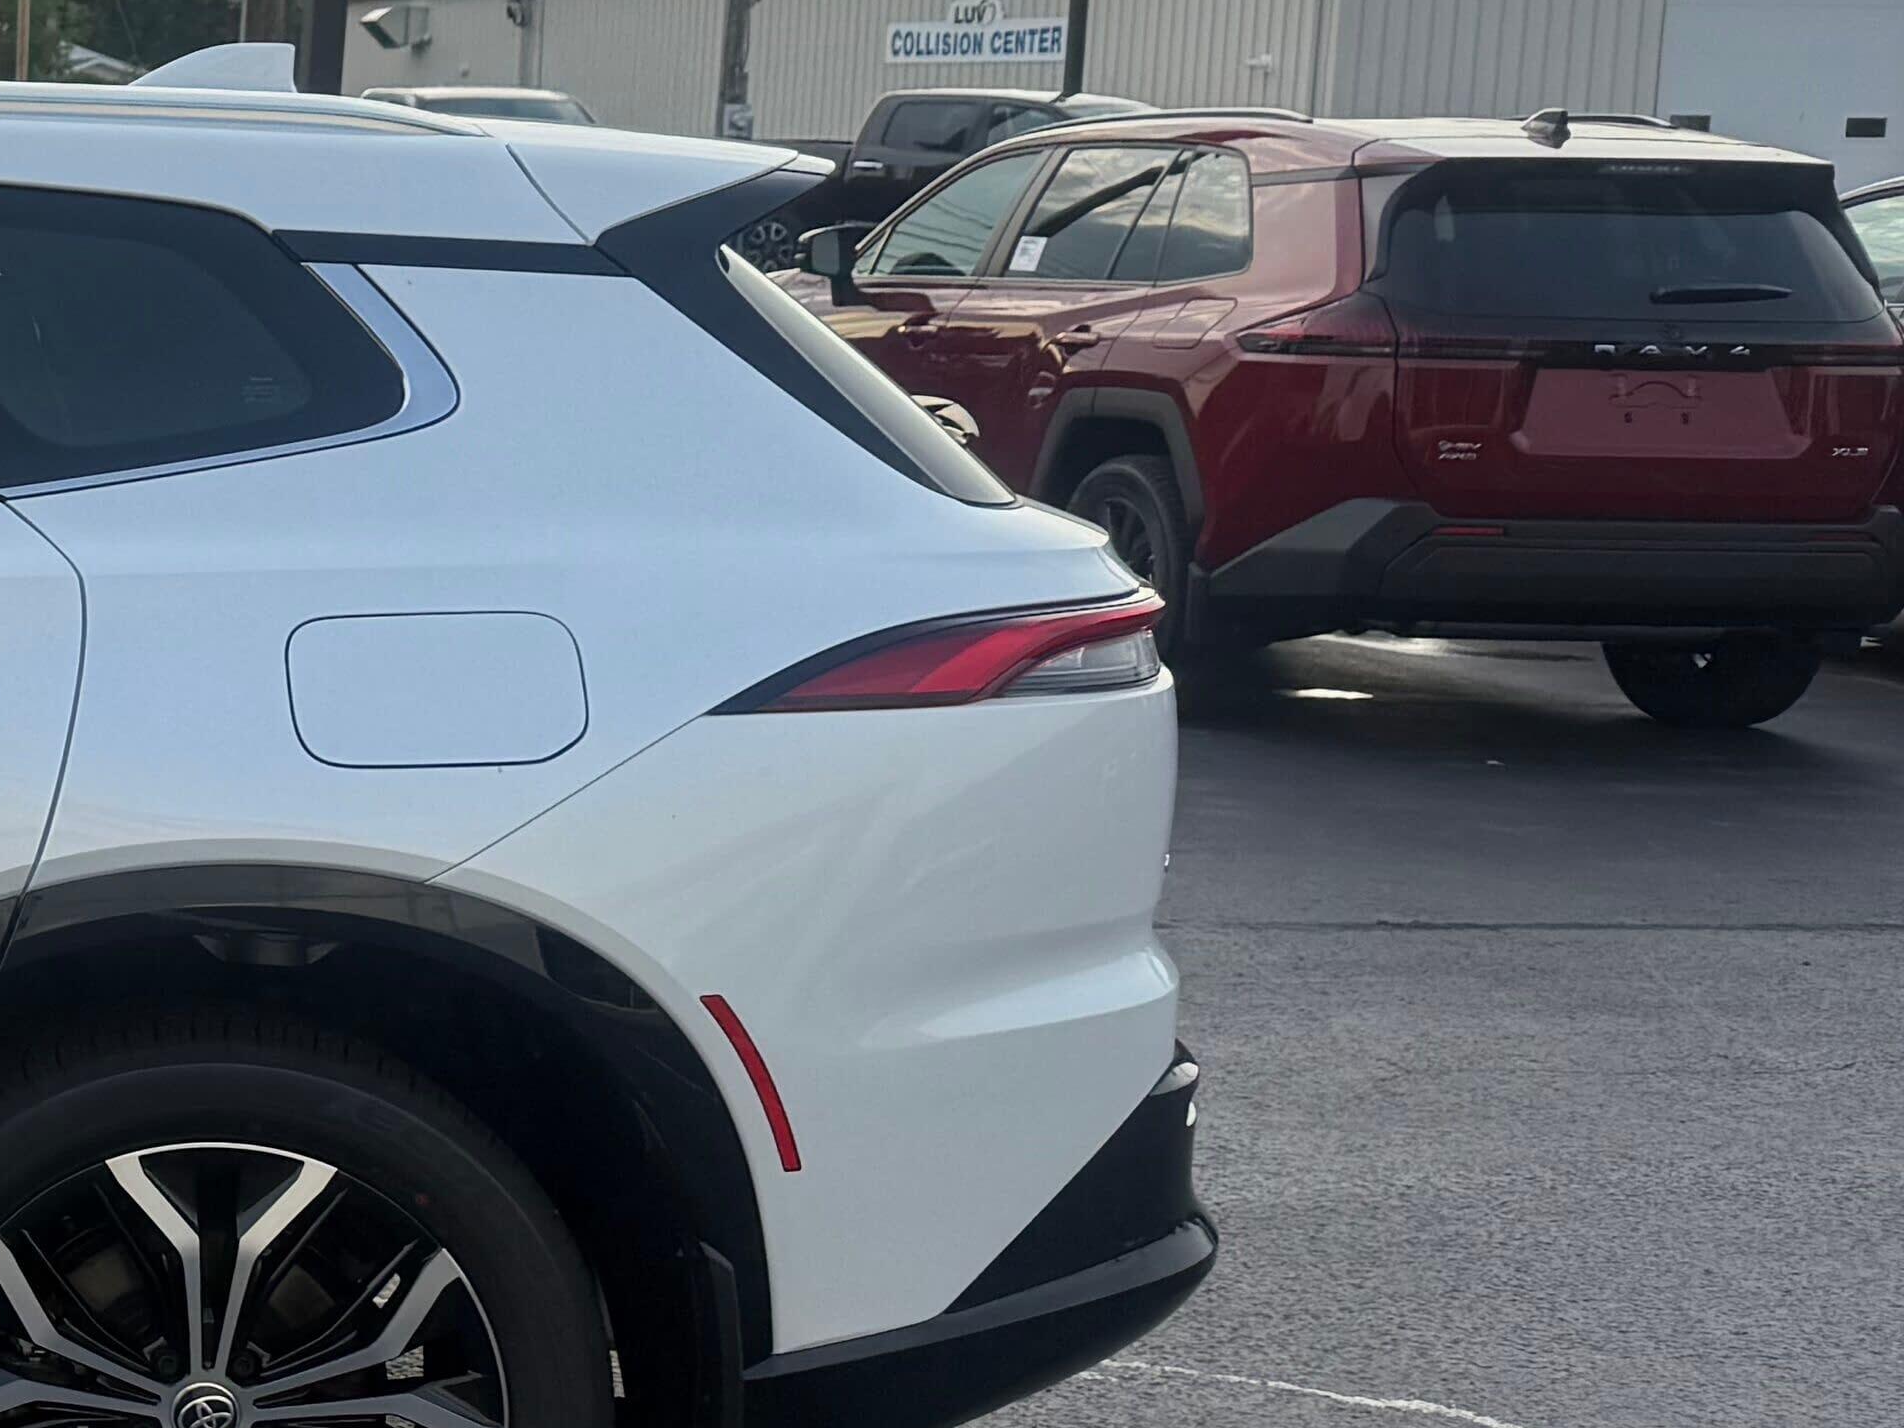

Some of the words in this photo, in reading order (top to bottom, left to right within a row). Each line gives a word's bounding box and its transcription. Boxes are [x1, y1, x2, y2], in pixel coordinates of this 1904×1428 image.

[953, 4, 988, 24] LUV
[891, 29, 984, 57] COLLISION
[991, 25, 1063, 55] CENTER
